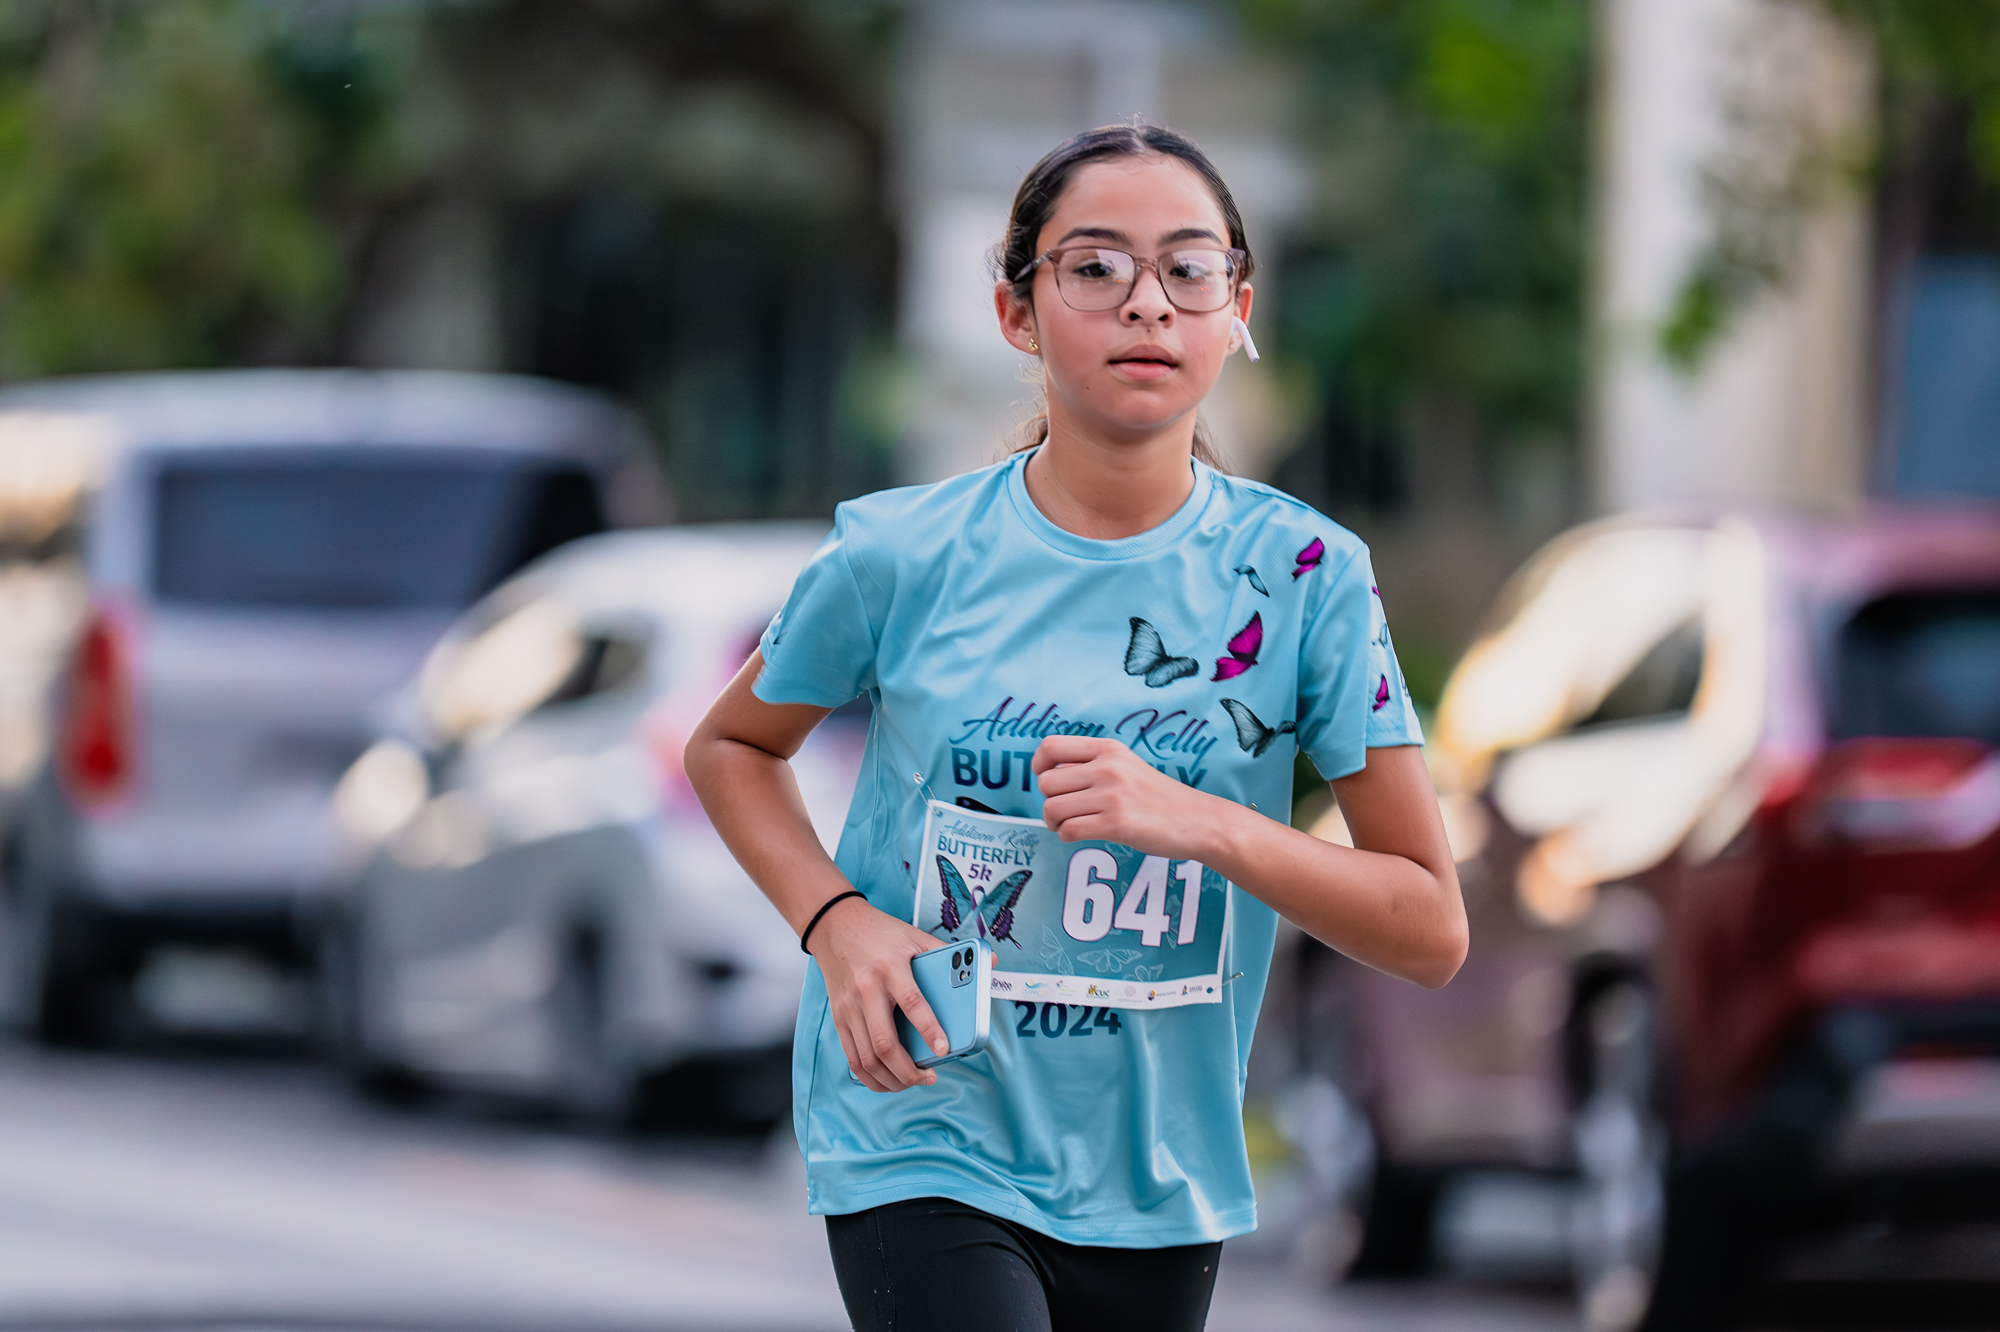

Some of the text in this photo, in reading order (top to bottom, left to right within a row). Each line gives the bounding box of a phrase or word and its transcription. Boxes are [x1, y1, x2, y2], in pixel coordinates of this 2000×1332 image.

[949, 696, 1105, 745] Addison
[1116, 709, 1217, 774] Kelly
[937, 834, 1036, 867] BUTTERFLY
[1061, 847, 1204, 948] 641
[1015, 1000, 1122, 1038] 2024
